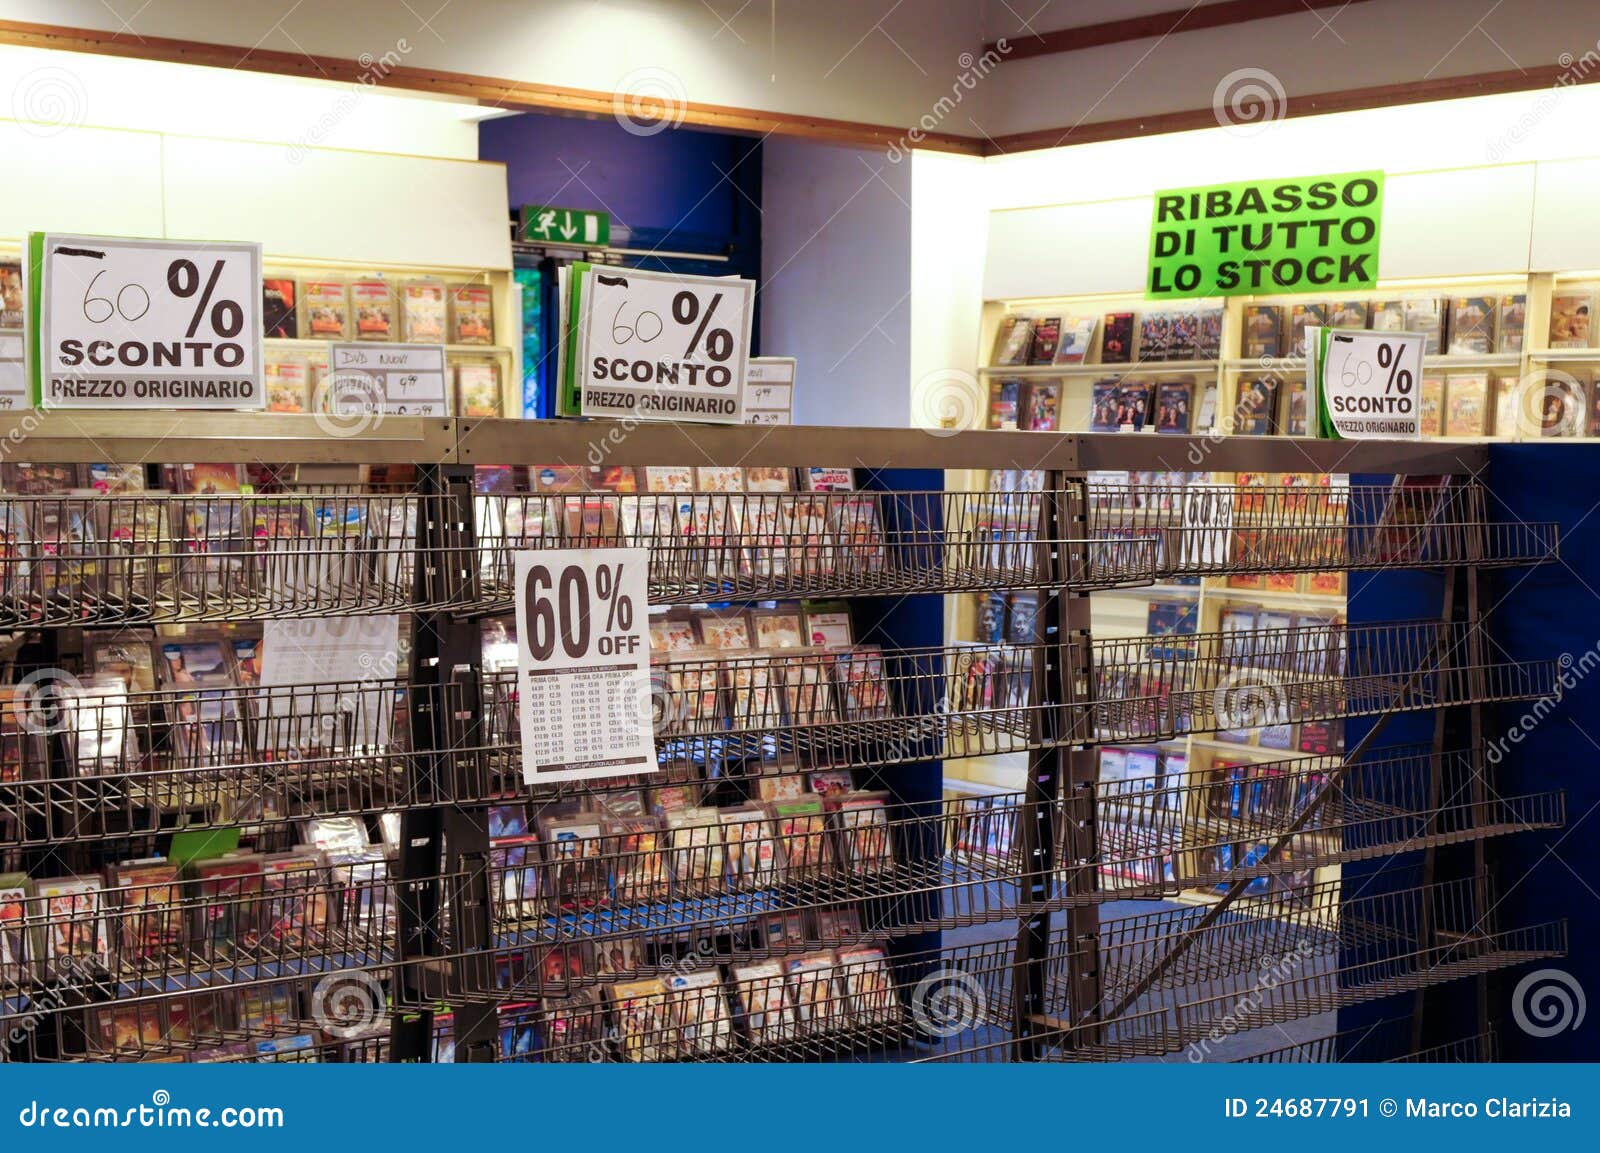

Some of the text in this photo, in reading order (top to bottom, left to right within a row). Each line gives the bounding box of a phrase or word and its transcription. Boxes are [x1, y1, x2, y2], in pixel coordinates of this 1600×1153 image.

[1157, 179, 1379, 222] RIBASSO
[1154, 216, 1376, 258] DI TUTTO
[1151, 254, 1372, 293] LO STOCK
[83, 258, 244, 338] 60 %
[613, 290, 734, 361] 60 %
[59, 340, 245, 367] SCONTO
[592, 357, 732, 387] SCONTO
[1341, 351, 1372, 387] 60
[51, 379, 253, 398] PREZZO ORIGINARIO
[586, 391, 635, 409] PREZZO
[641, 394, 736, 416] ORIGINARIO
[1333, 396, 1412, 414] SCONTO
[1334, 419, 1415, 434] PREZZO ORIGINARIO
[598, 635, 640, 655] OFF
